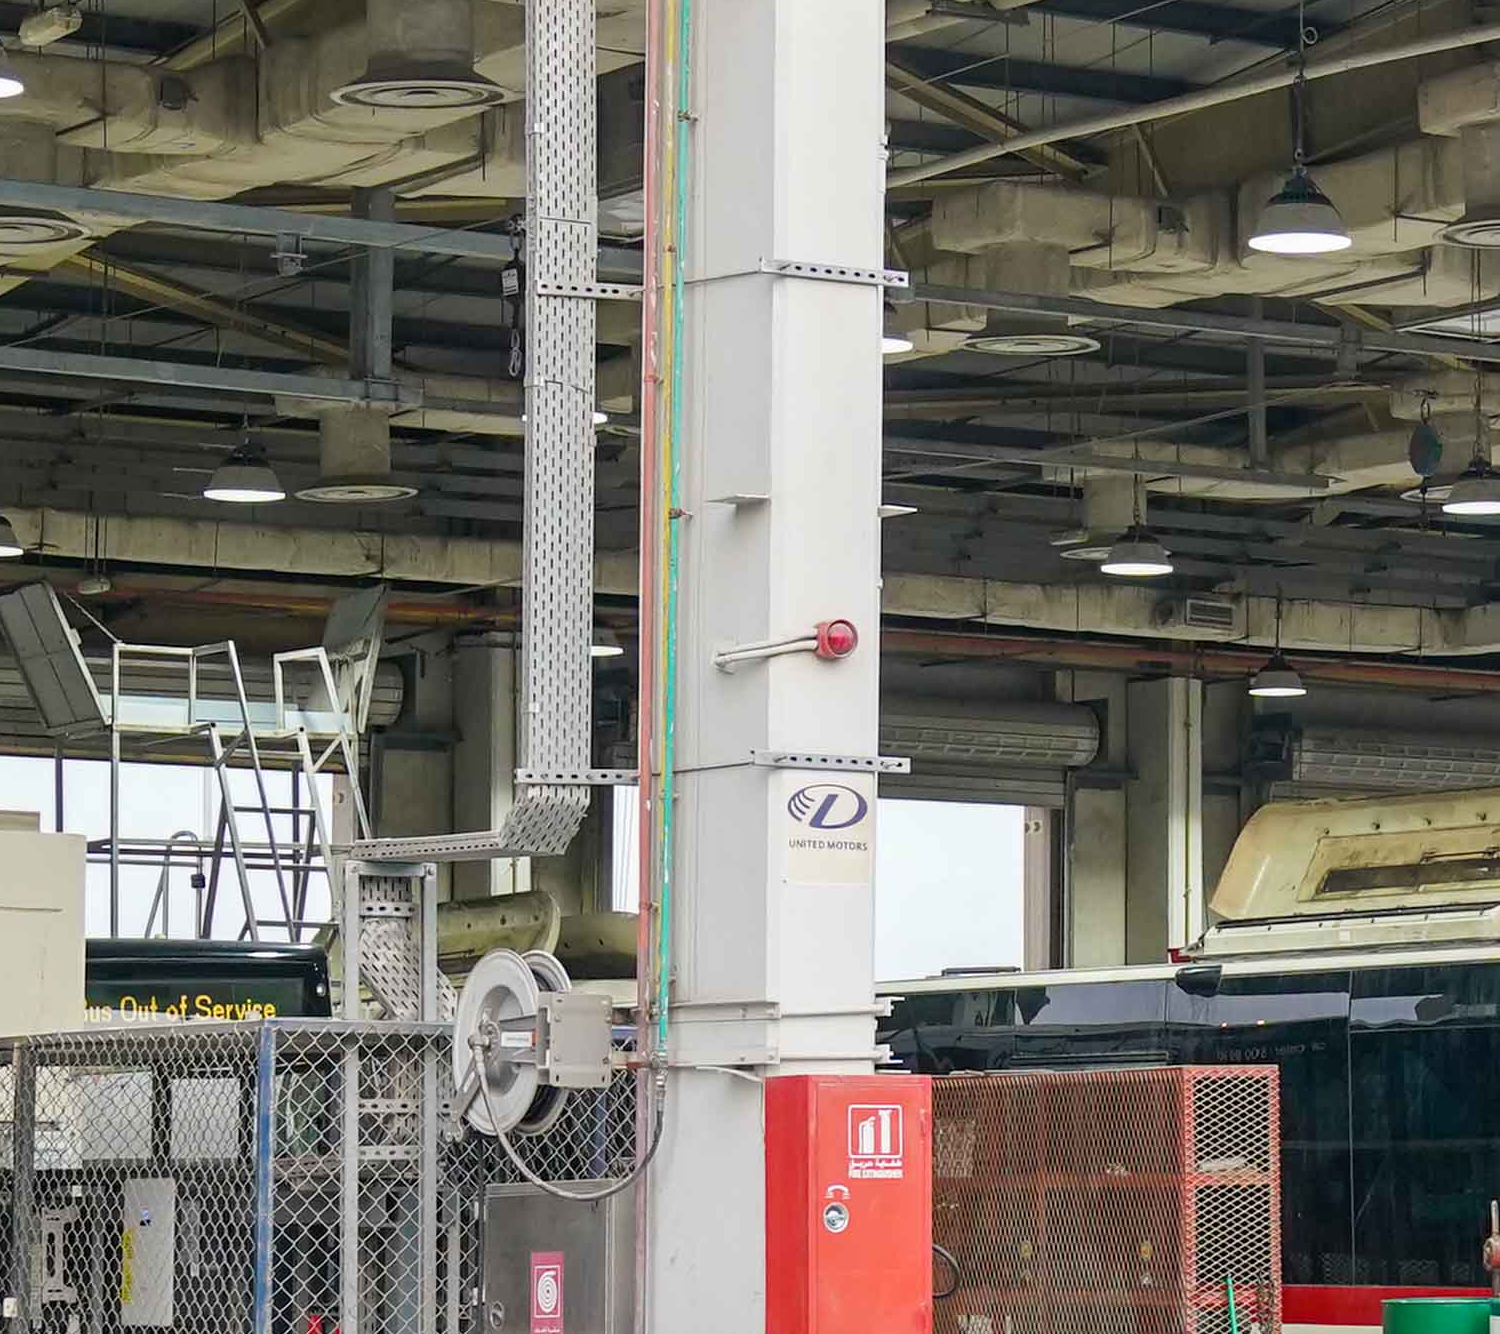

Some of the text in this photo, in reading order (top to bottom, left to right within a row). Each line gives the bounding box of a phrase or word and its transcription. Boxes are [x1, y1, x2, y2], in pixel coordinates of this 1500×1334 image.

[788, 839, 868, 851] UNITED MOTORS
[84, 994, 277, 1022] us Out of Service
